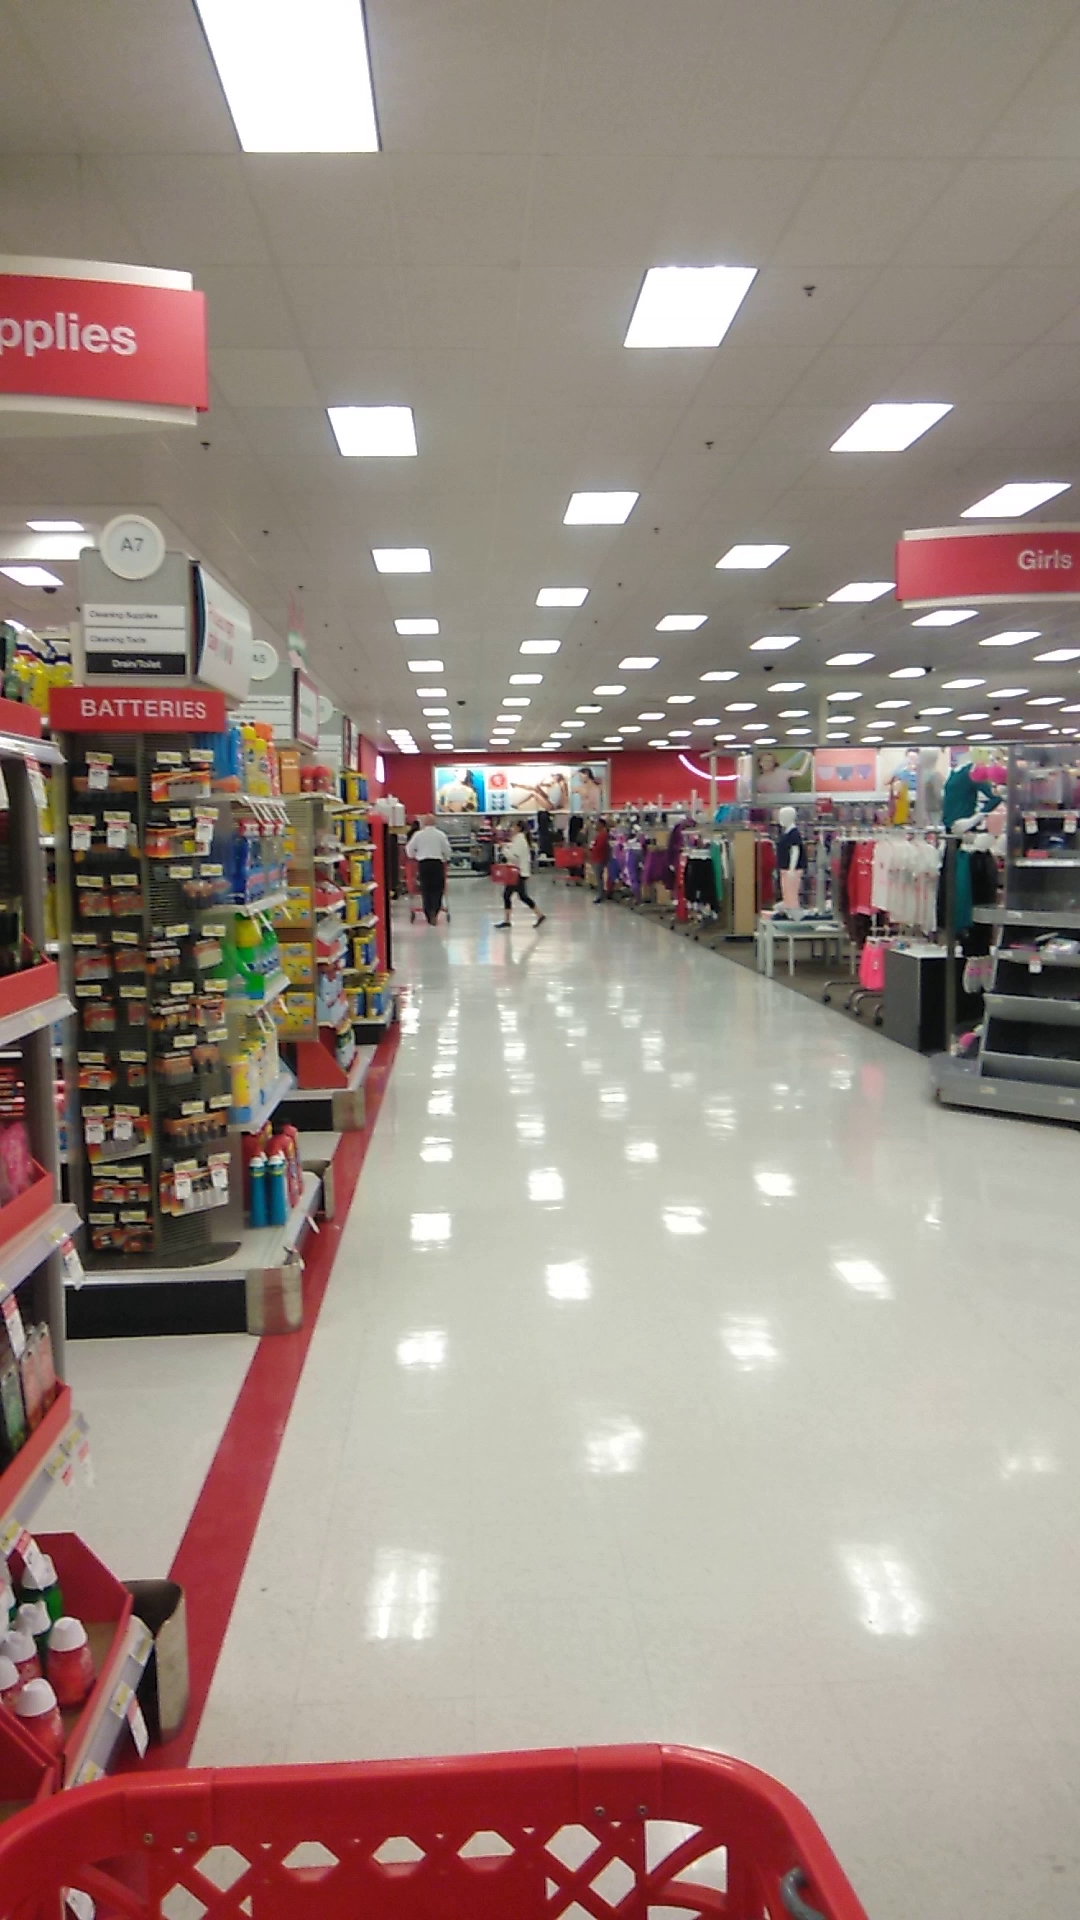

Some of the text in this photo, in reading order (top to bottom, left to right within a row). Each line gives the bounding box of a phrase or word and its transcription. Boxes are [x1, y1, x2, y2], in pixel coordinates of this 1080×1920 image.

[0, 312, 137, 357] pplies
[121, 537, 143, 551] A7
[1017, 549, 1072, 570] Girls
[80, 699, 207, 719] BATTERIES
